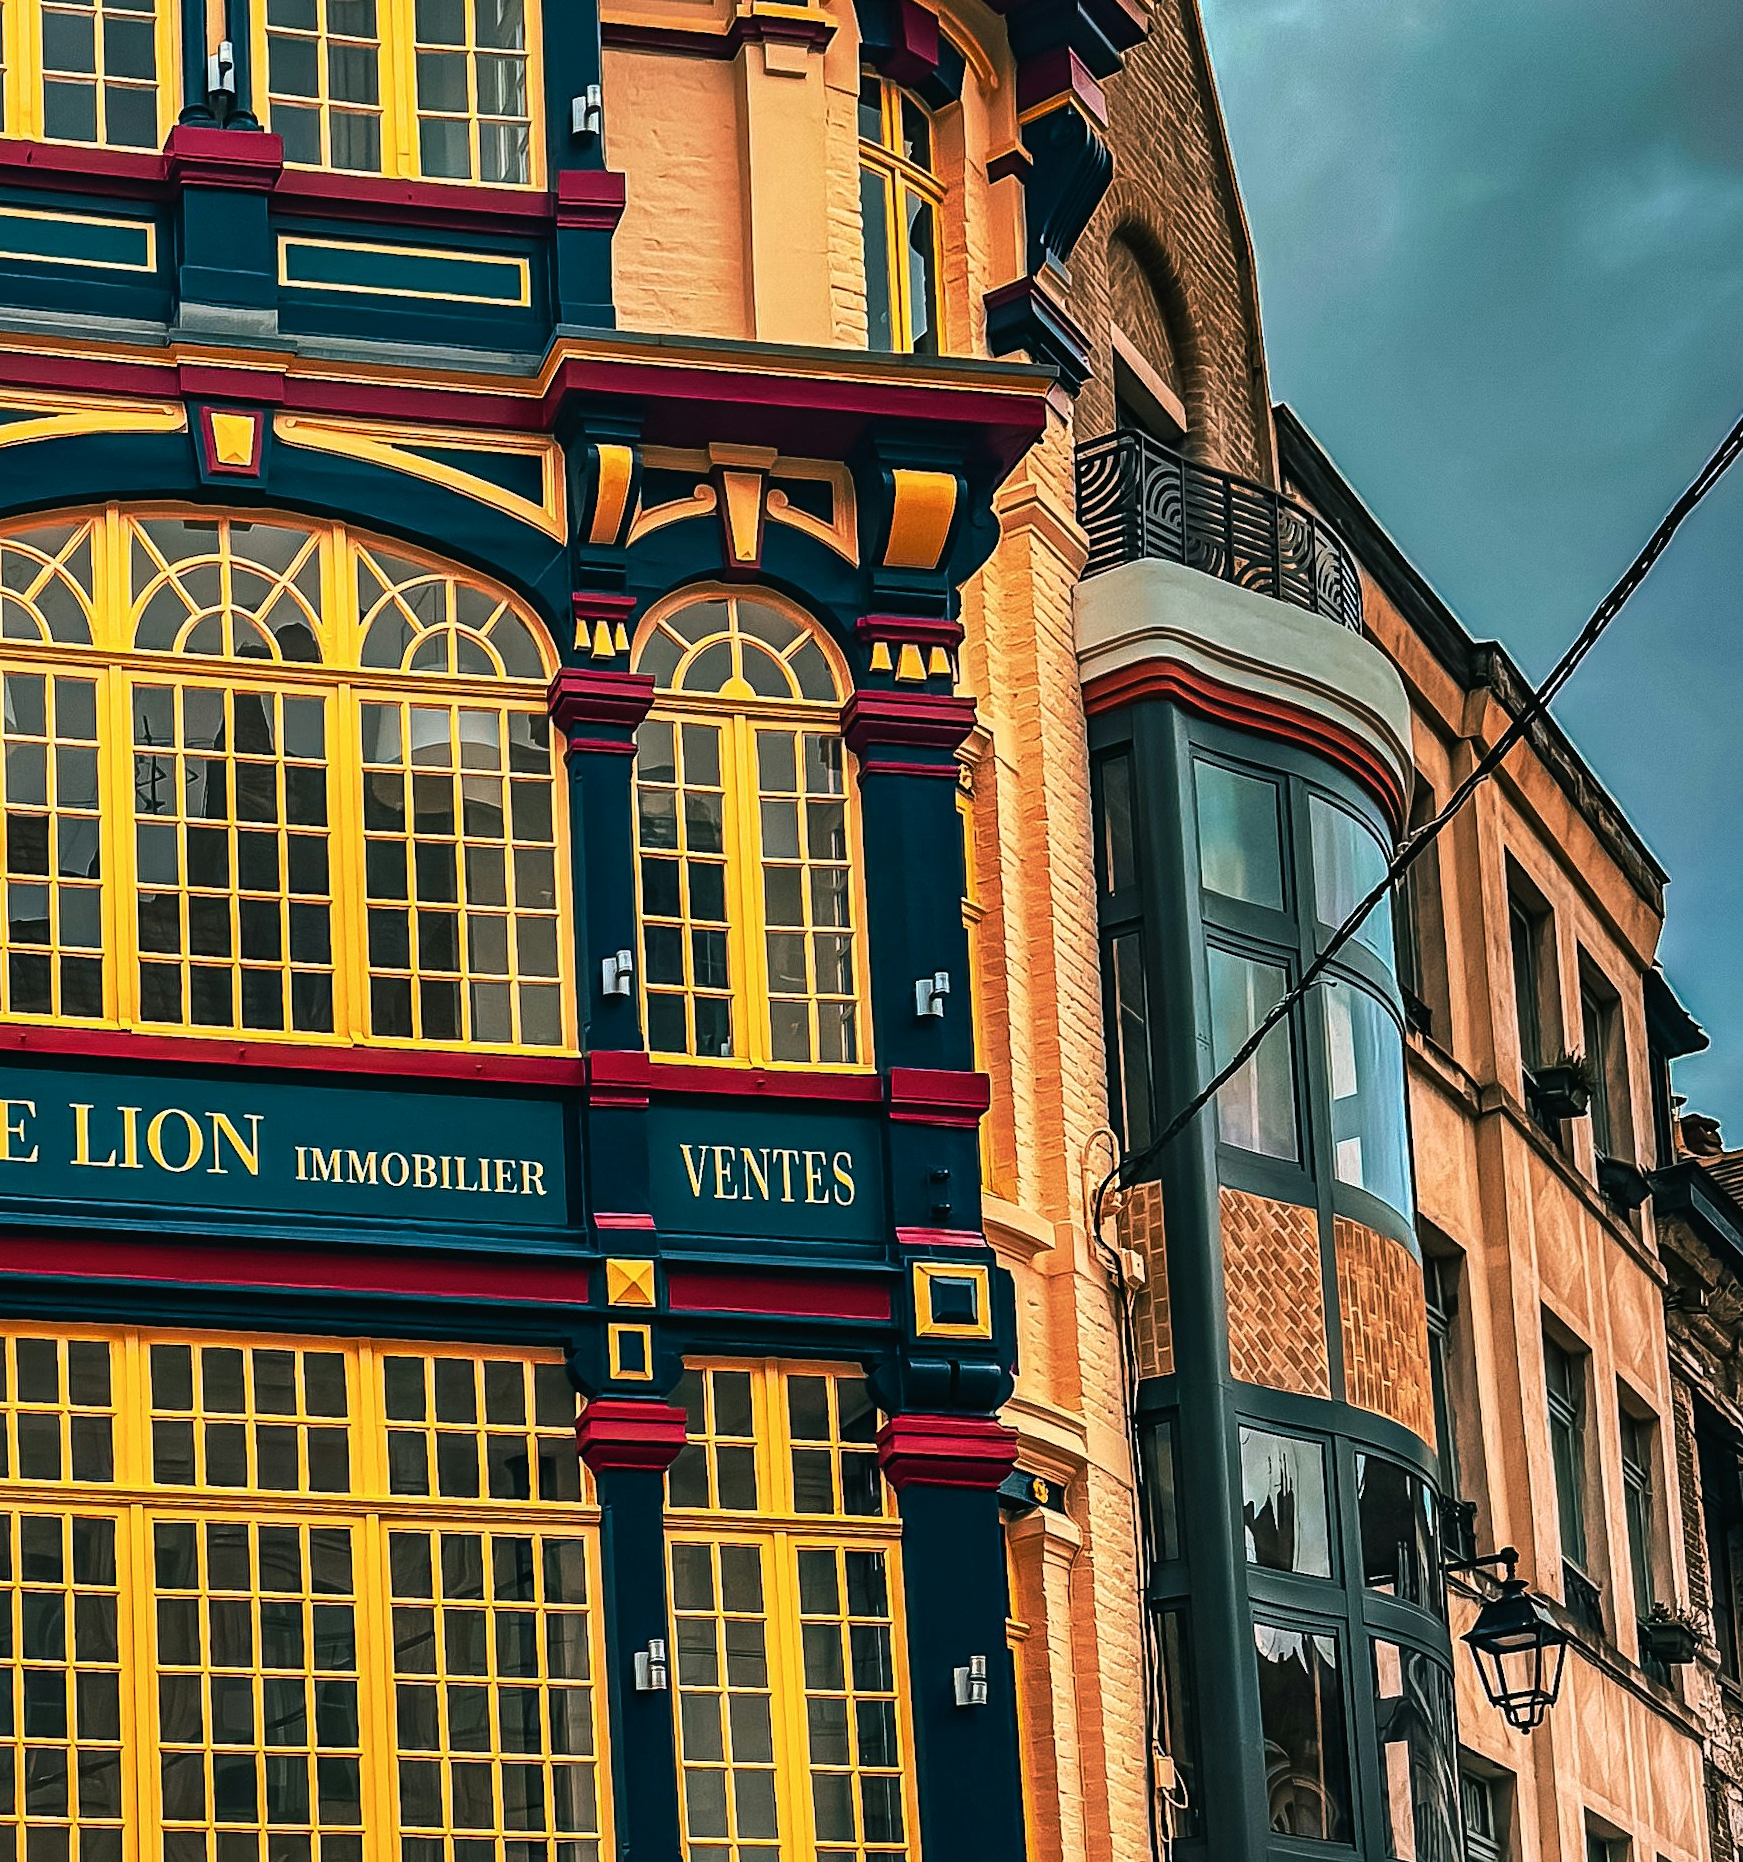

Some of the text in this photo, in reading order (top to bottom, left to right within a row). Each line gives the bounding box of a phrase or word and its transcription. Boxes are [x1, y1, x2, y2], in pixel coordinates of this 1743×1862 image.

[69, 1104, 264, 1177] LION
[295, 1146, 548, 1196] IMMOBILIER
[679, 1143, 855, 1206] VENTES
